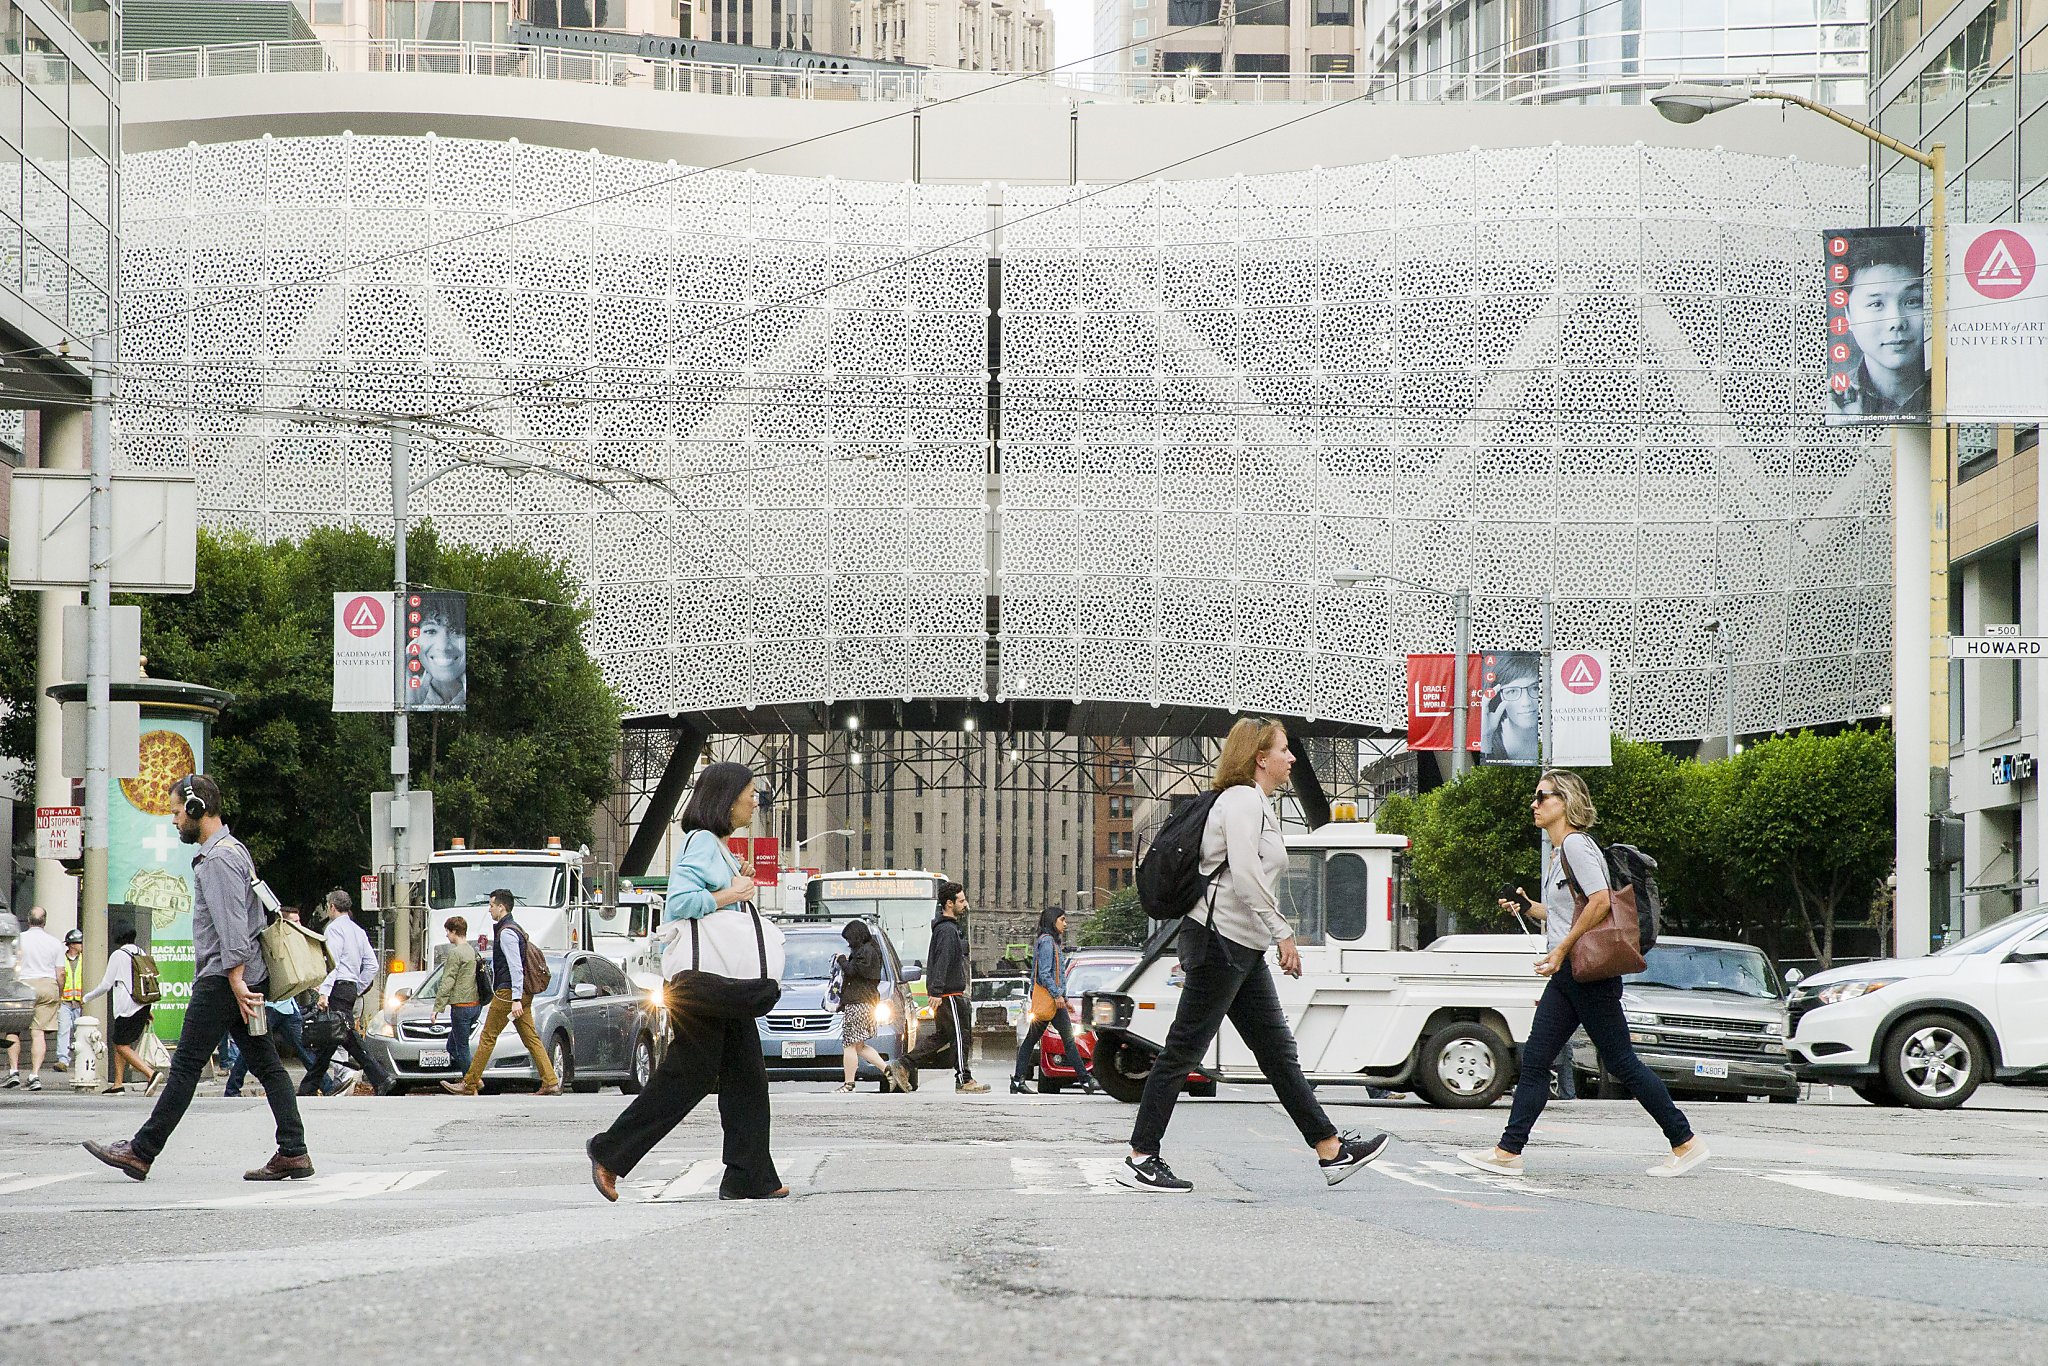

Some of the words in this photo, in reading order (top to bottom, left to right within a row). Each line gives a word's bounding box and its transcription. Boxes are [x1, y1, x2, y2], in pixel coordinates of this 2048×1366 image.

[1832, 238, 1848, 389] DESIGN
[1950, 322, 2010, 332] ACADEMY
[2011, 322, 2021, 334] of
[2021, 322, 2046, 332] ART
[1950, 335, 2046, 346] UNIVERSITY
[1998, 626, 2016, 635] 500
[410, 597, 420, 688] CREATE
[1967, 641, 2041, 654] HOWARD
[1486, 656, 1495, 698] ACT
[1422, 685, 1447, 693] ORACLE
[1422, 693, 1440, 701] OPEN
[1423, 701, 1446, 709] WORLD
[41, 808, 77, 816] TOW-AWAY
[37, 816, 49, 828] NO
[50, 817, 80, 827] STOPPING
[50, 829, 67, 838] ANY
[49, 839, 68, 849] TIME
[830, 880, 844, 896] 54
[855, 881, 870, 889] SAN
[151, 945, 175, 954] BACK
[176, 946, 186, 954] AT
